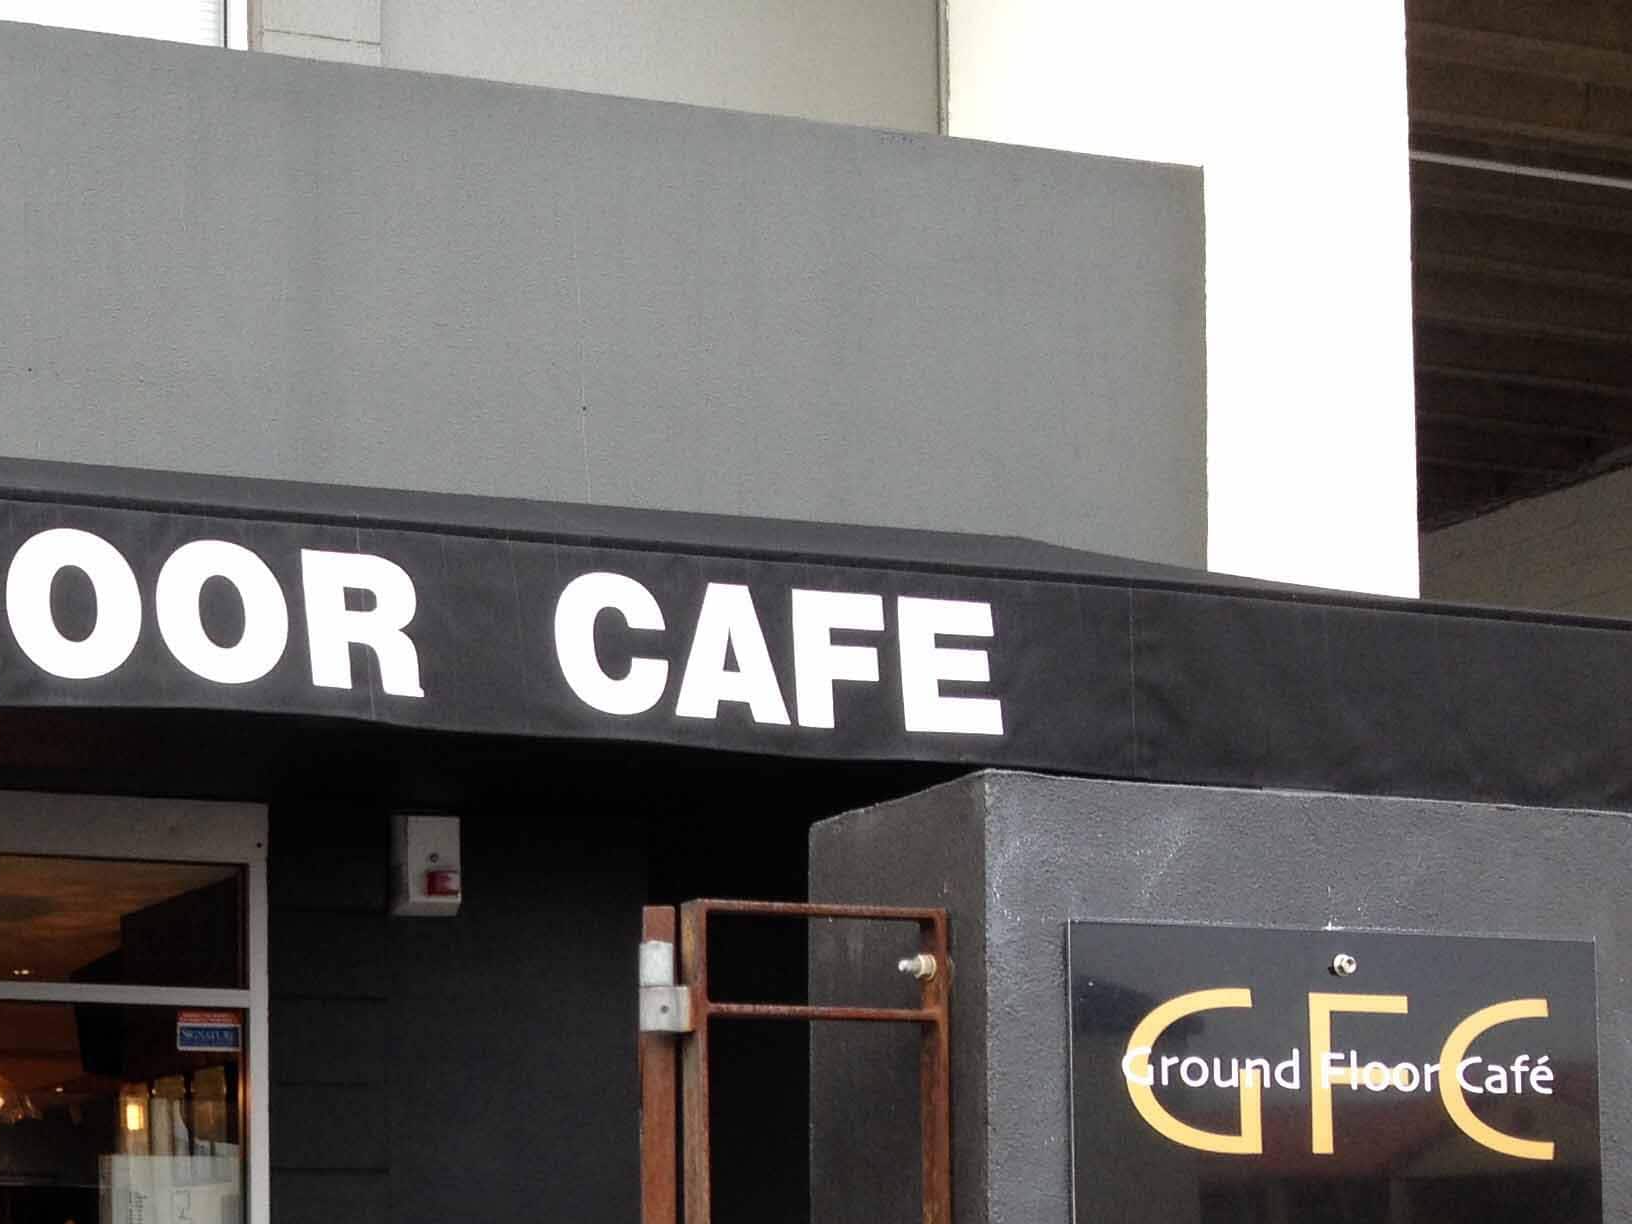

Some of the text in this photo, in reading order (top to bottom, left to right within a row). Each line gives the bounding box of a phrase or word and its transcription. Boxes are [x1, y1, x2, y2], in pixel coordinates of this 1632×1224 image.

[554, 572, 1004, 735] CAFE
[1121, 1047, 1555, 1094] Ground Floor Café
[1125, 988, 1555, 1161] GFC
